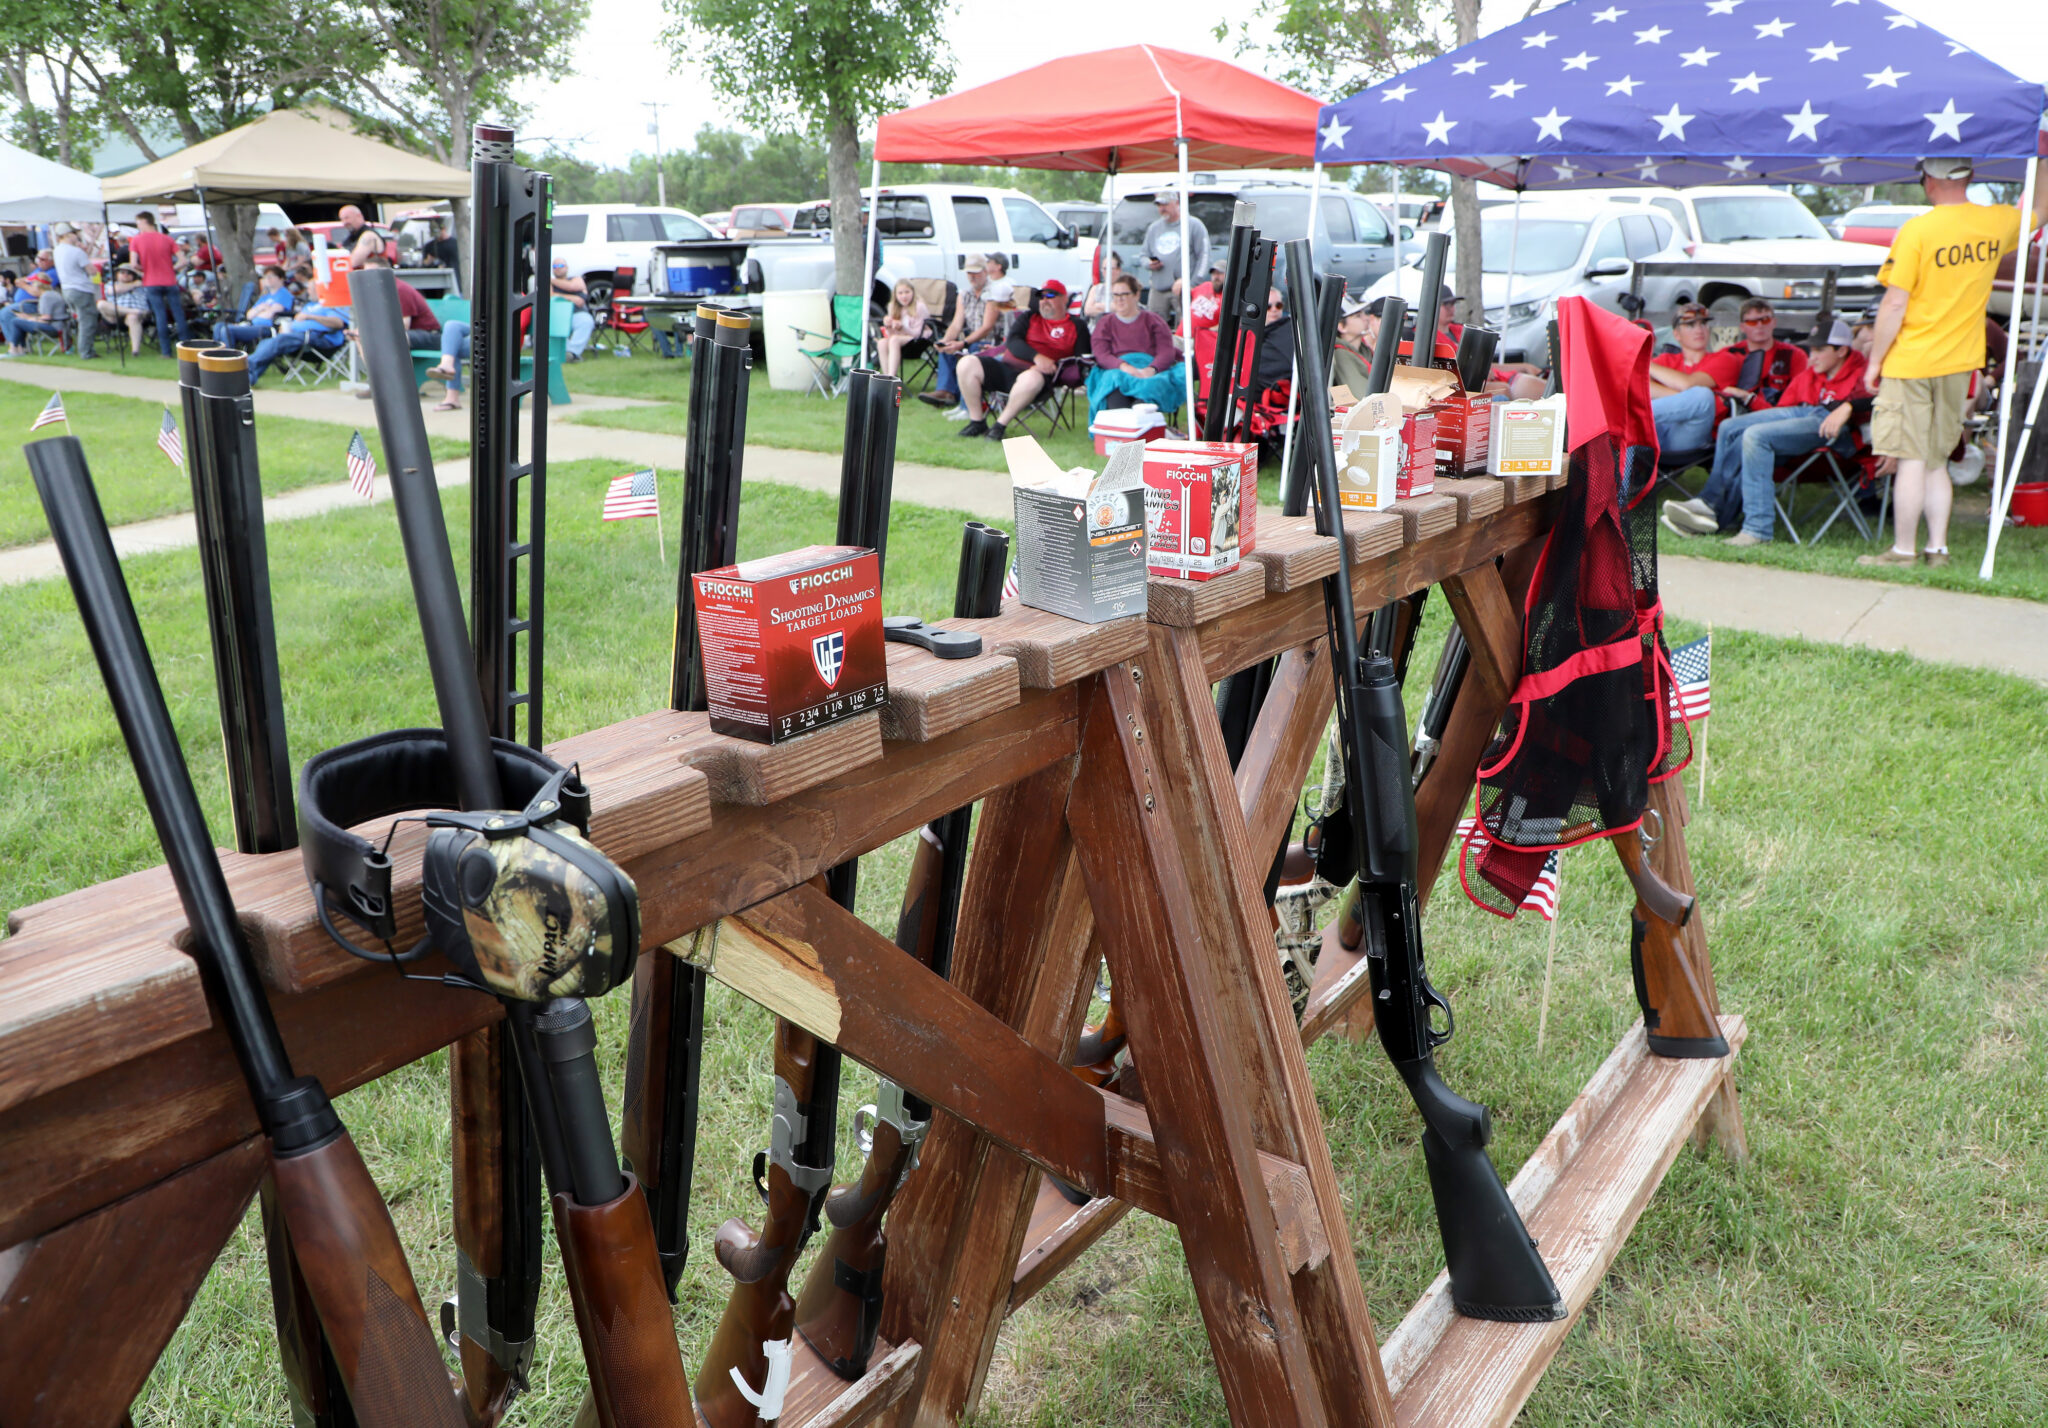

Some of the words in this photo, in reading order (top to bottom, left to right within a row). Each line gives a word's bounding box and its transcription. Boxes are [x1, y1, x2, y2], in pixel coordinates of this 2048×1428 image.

[1935, 240, 2001, 268] COACH
[1166, 470, 1207, 482] FIOCCHI
[1144, 488, 1172, 499] TING
[1144, 499, 1180, 511] AMICS
[1101, 533, 1133, 543] TRAP
[1149, 532, 1179, 541] ARGET
[801, 566, 853, 590] FIOCCHI
[707, 581, 753, 598] FIOCCHI
[786, 614, 828, 633] TARGET
[830, 604, 863, 621] LOADS
[873, 686, 884, 698] 7.5
[849, 691, 867, 706] 1165
[831, 700, 843, 712] 1/8
[800, 713, 806, 723] 2
[807, 708, 819, 721] 3/4
[781, 717, 792, 729] 12
